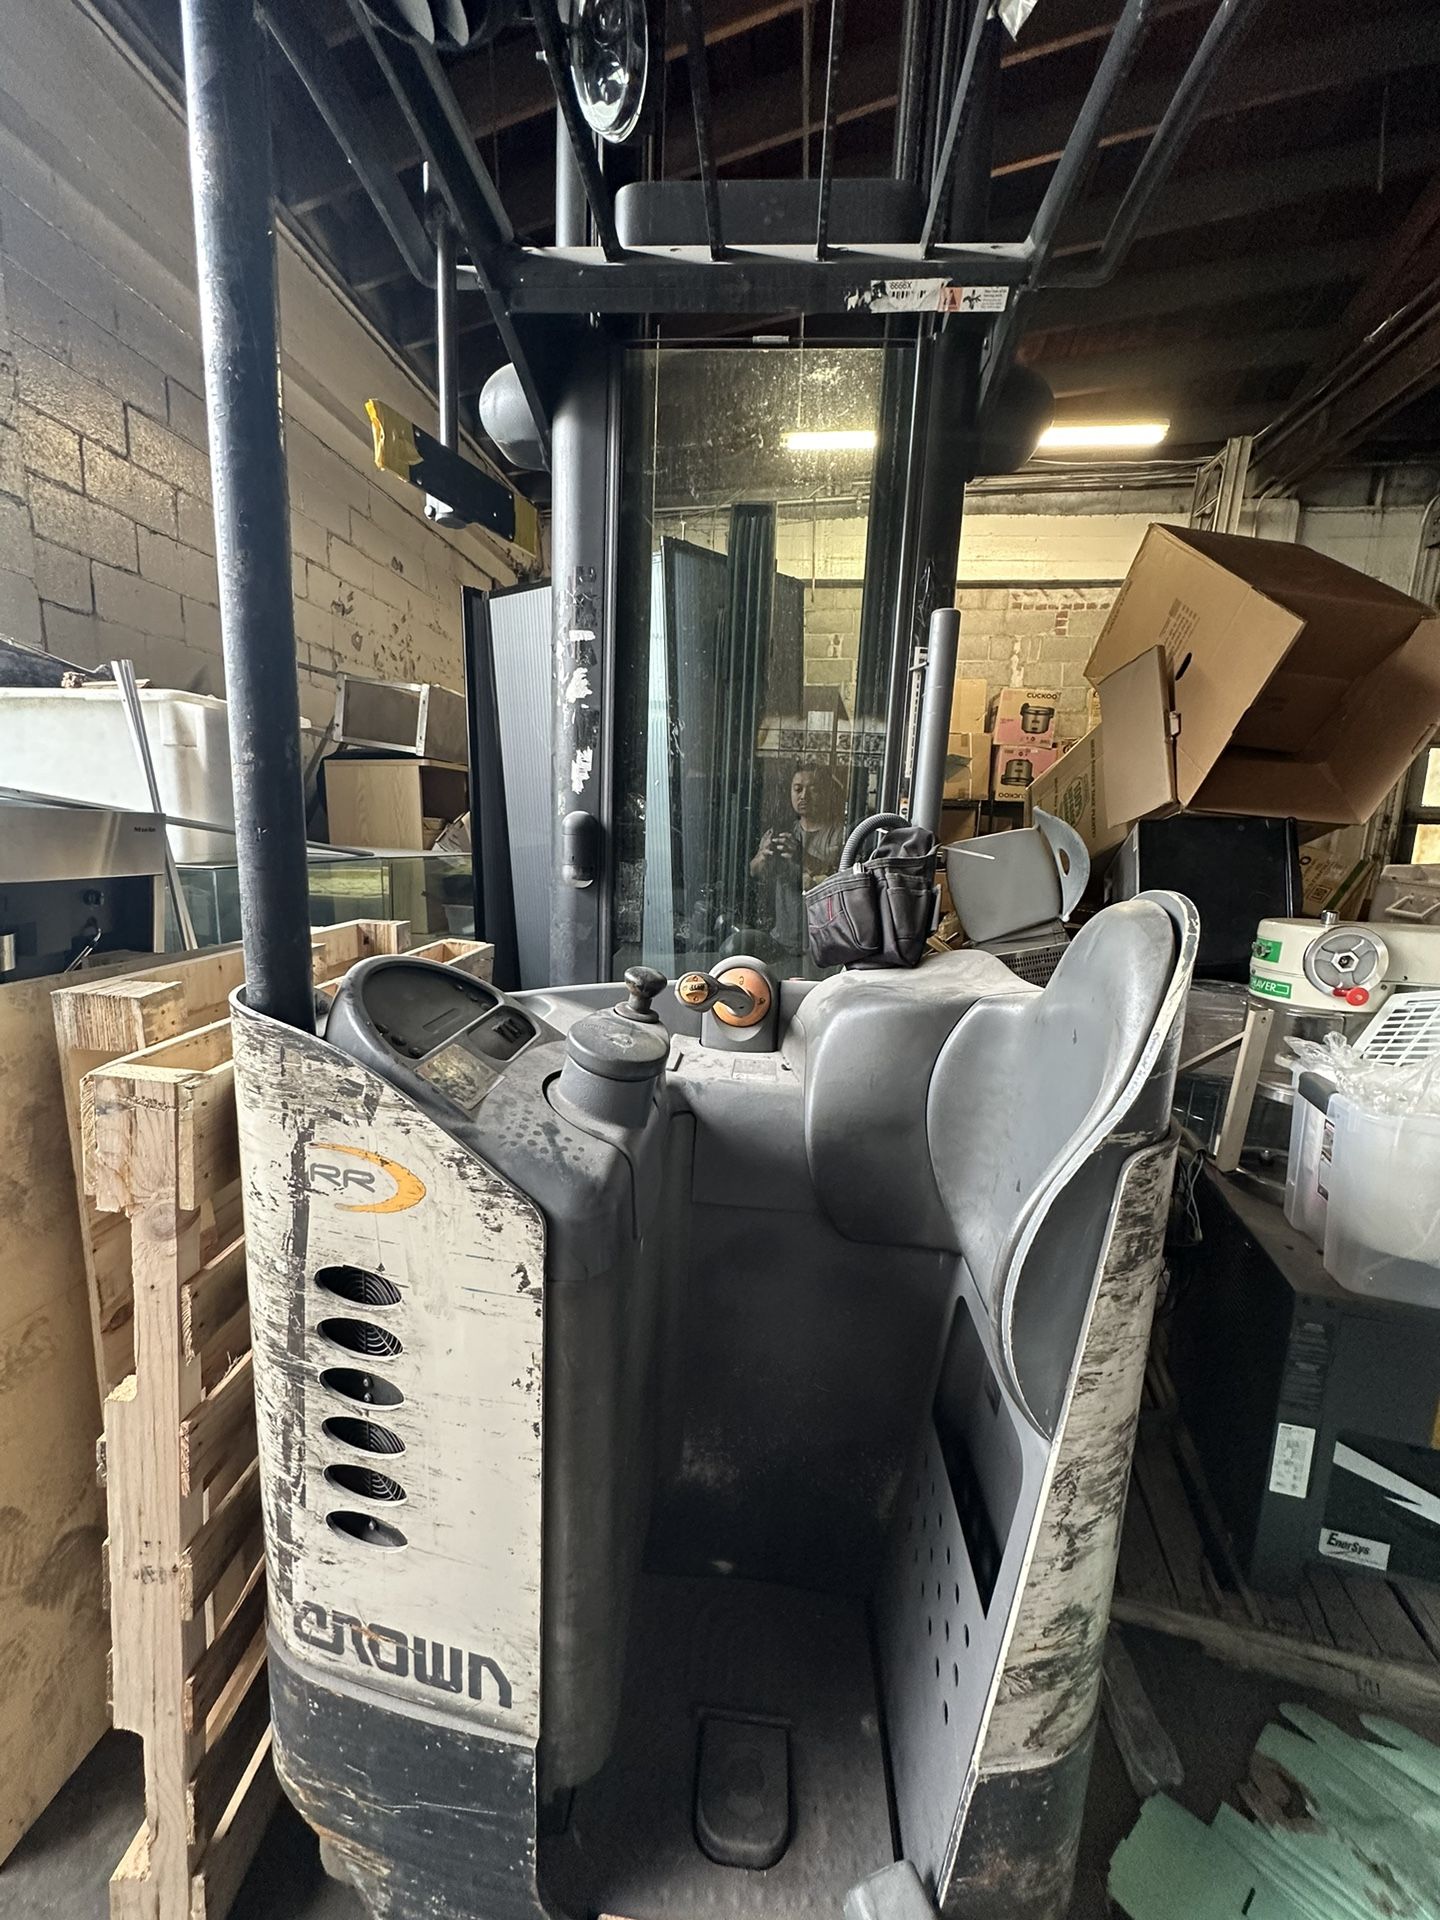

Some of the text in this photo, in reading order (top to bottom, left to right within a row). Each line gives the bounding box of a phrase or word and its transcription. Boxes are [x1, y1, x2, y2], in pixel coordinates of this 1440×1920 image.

[1026, 692, 1058, 700] CUCKOO
[309, 1163, 376, 1193] RR
[1327, 1532, 1371, 1555] EnerSys
[293, 1600, 513, 1710] CROWN
